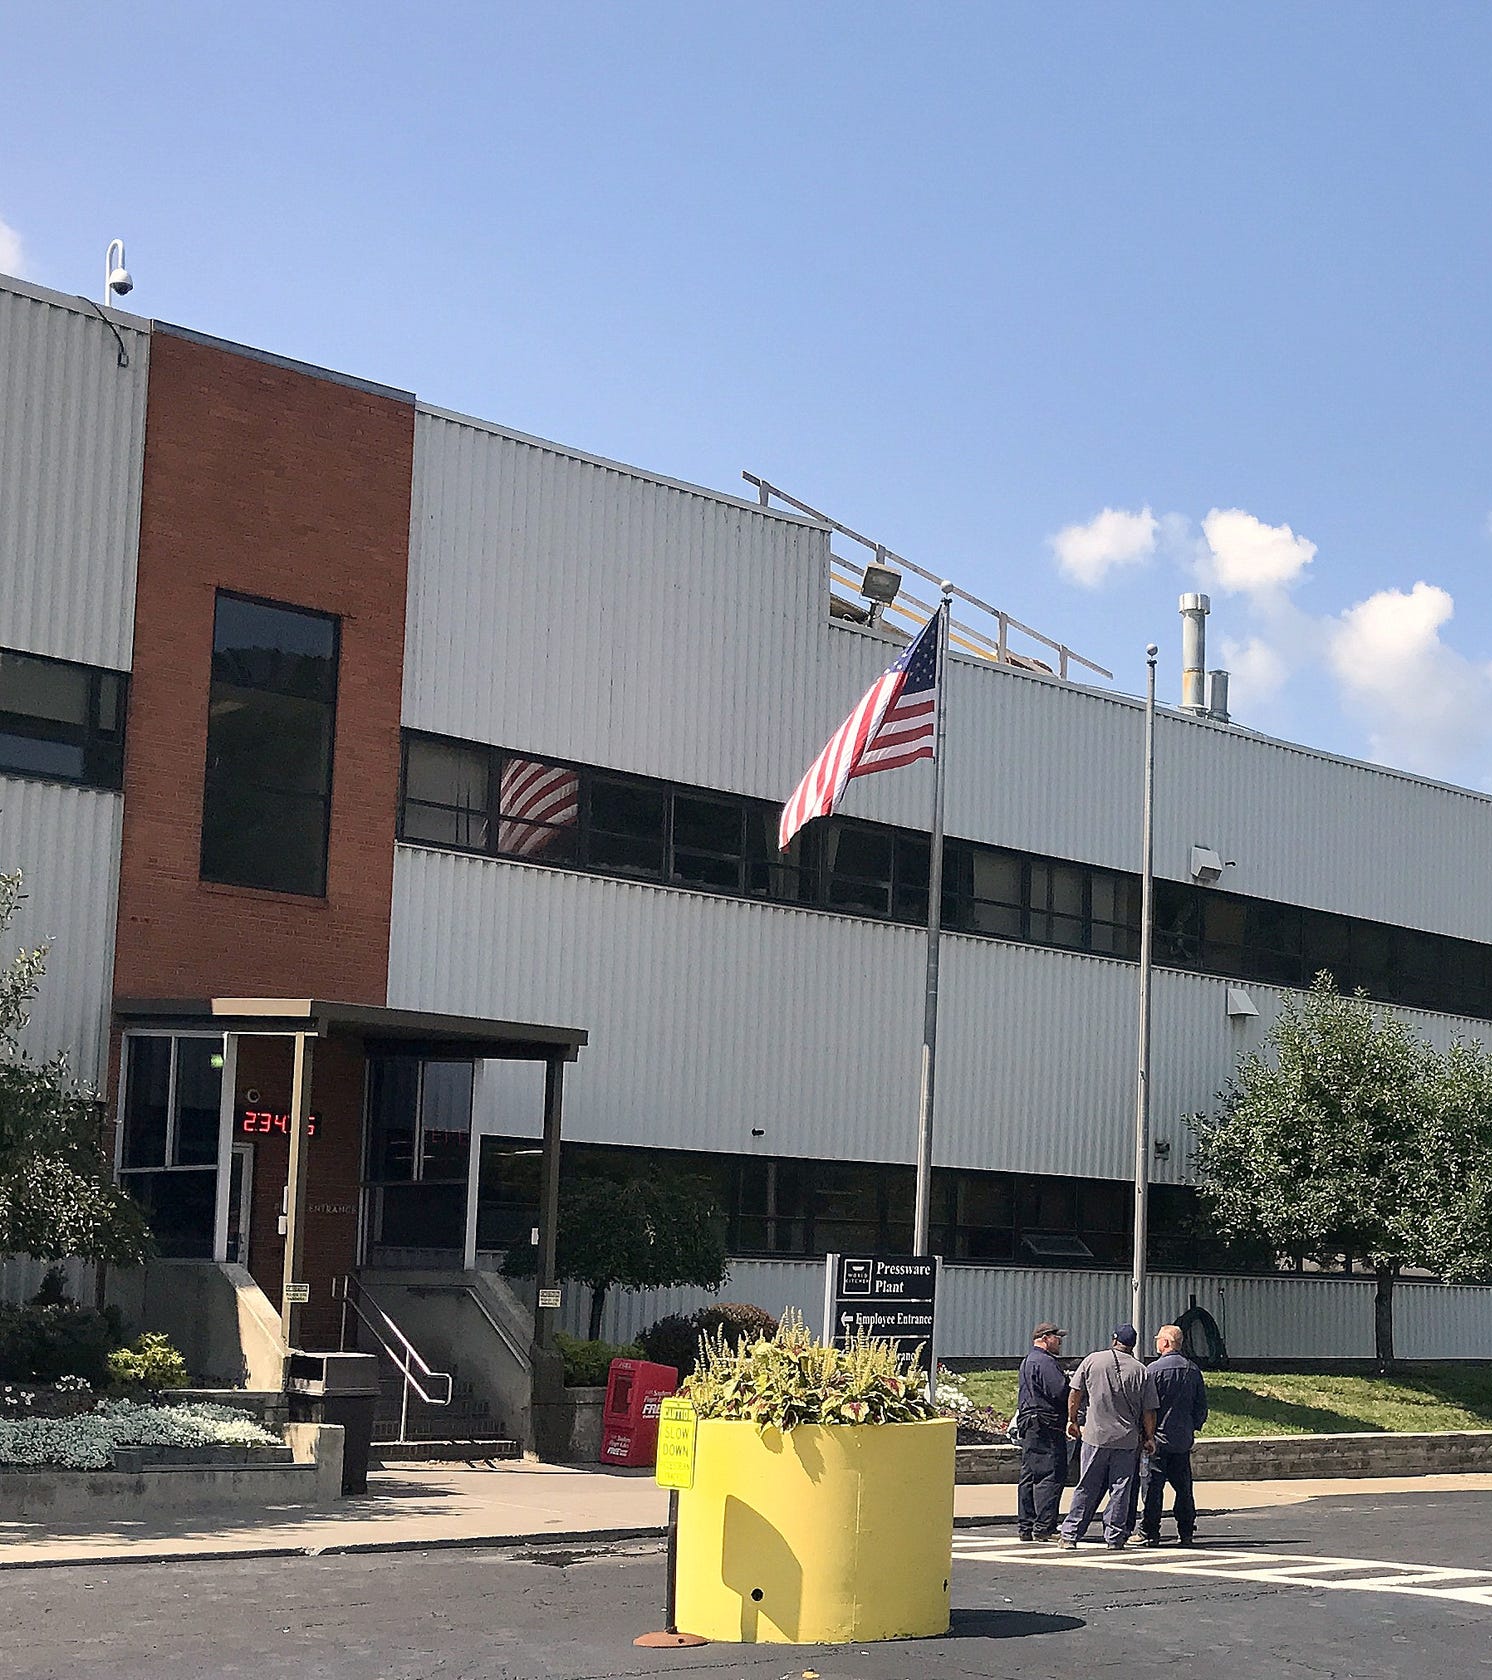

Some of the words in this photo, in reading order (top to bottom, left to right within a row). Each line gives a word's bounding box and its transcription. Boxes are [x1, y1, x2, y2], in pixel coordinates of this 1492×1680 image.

[876, 1261, 931, 1276] Pressware
[875, 1280, 905, 1293] Plant
[855, 1312, 896, 1328] Employee
[897, 1312, 933, 1325] Entrance
[664, 1426, 690, 1440] SLOW
[662, 1442, 689, 1458] DOWN
